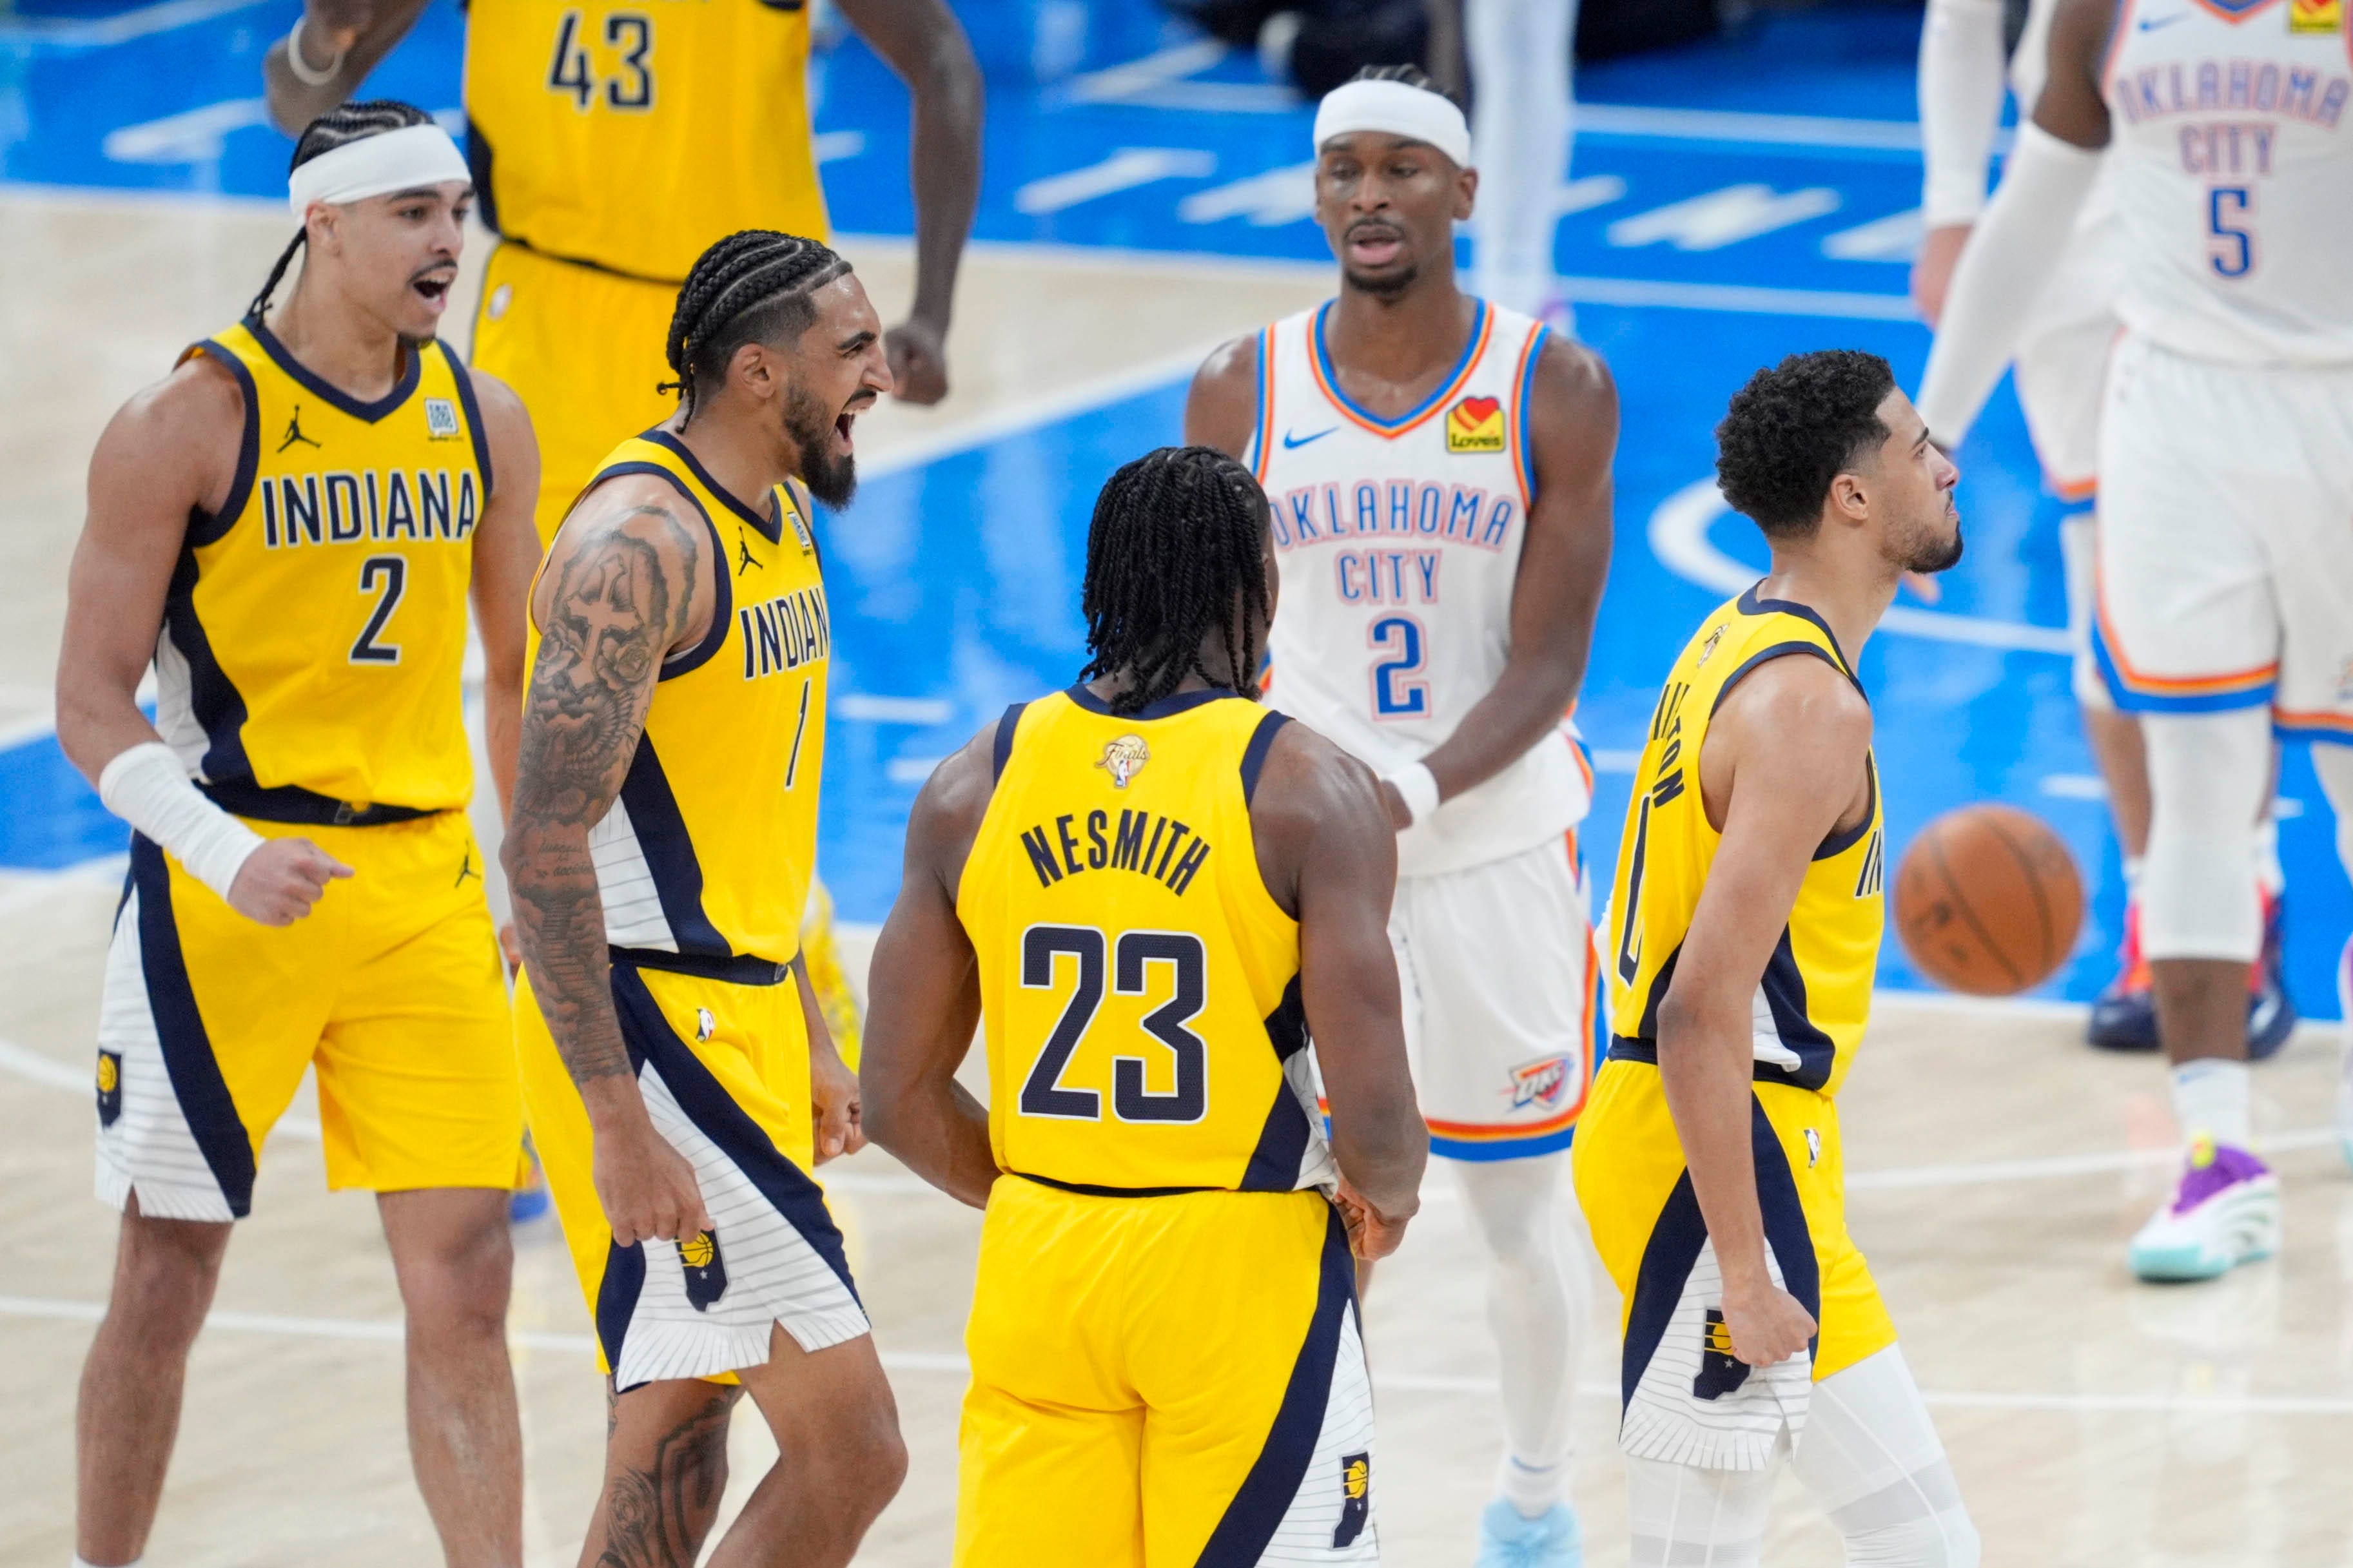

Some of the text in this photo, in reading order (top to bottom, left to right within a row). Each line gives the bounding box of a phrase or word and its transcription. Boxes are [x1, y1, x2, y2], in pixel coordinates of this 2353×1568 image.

[548, 12, 656, 113] 43
[2179, 121, 2278, 177] CITY
[2208, 184, 2254, 278] 5
[261, 468, 475, 550] INDIANA
[1269, 479, 1519, 554] OKLAHOMA
[349, 554, 408, 665] 2
[1334, 548, 1443, 606] CITY
[1367, 610, 1432, 722] 2
[785, 677, 811, 790] 1
[1020, 808, 1211, 897] NESMITH
[1019, 922, 1209, 1125] 23
